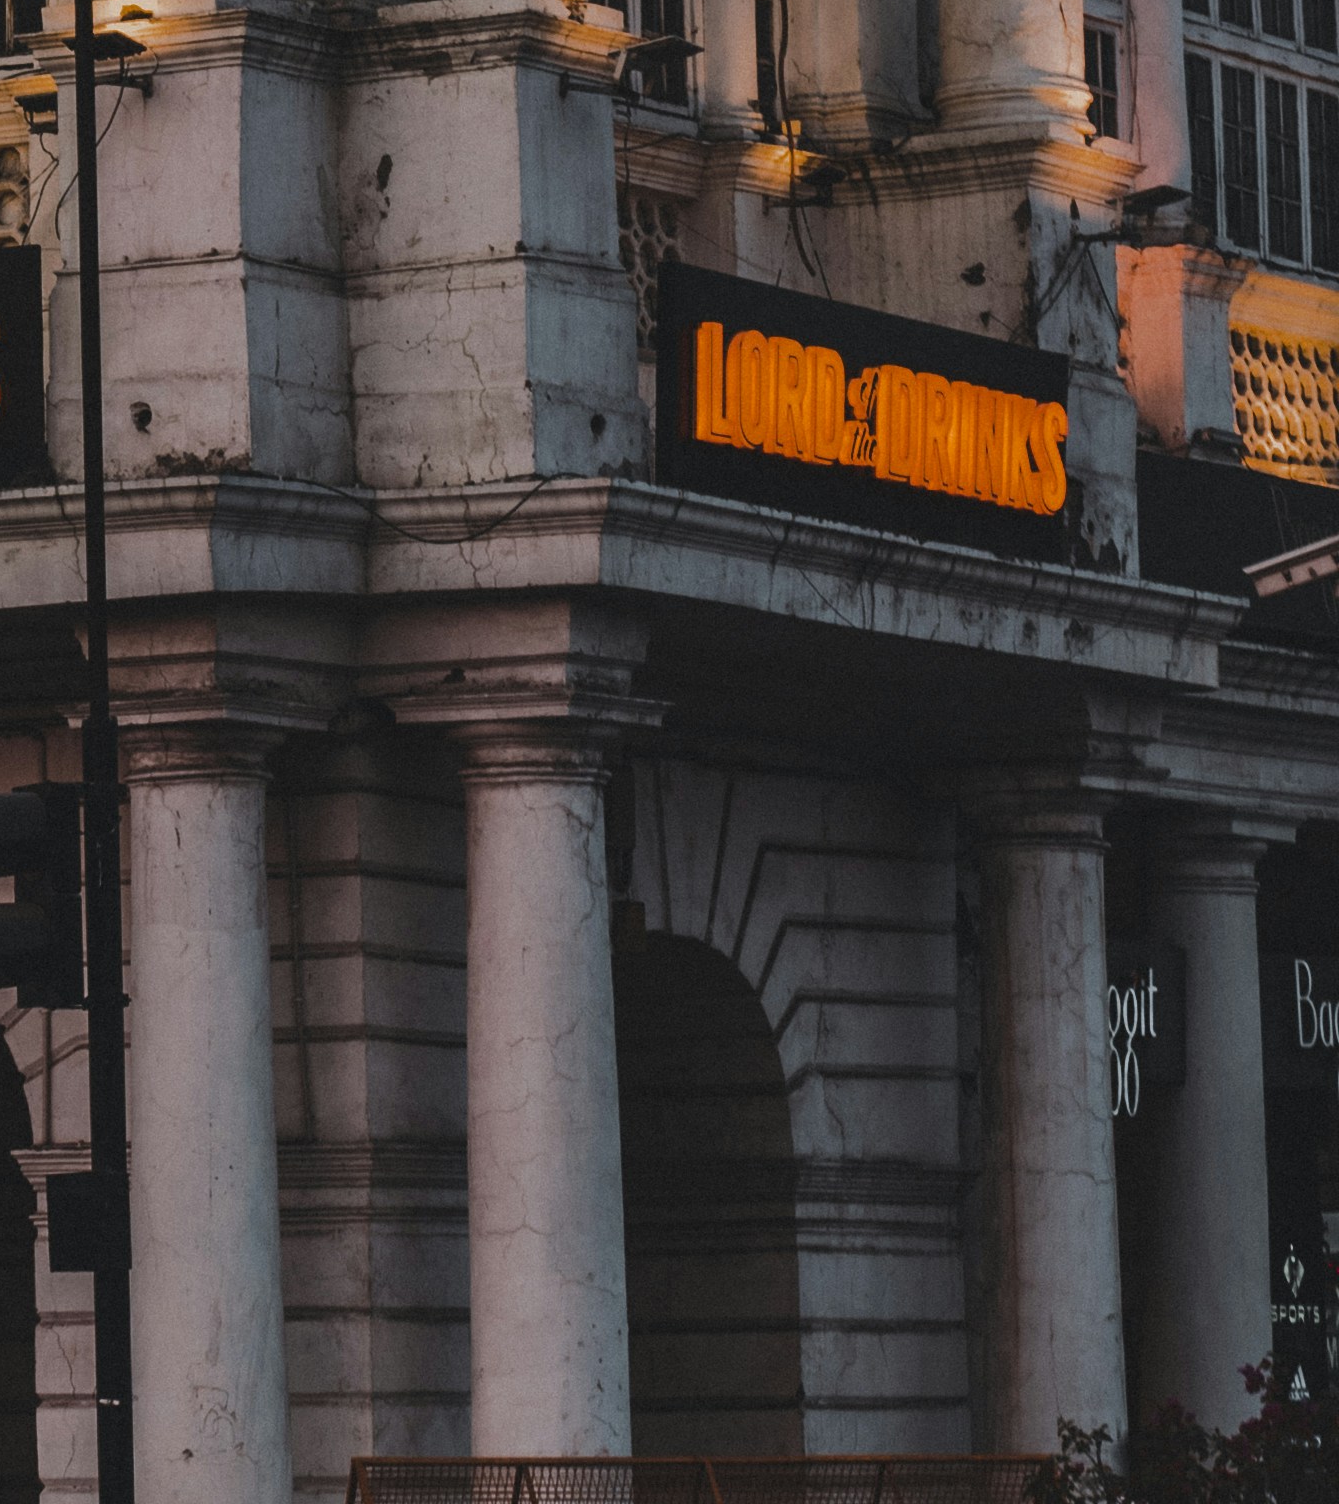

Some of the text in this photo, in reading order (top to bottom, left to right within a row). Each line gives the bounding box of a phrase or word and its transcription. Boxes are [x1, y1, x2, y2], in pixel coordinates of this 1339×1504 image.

[695, 321, 1070, 517] LORD of the DRINKS
